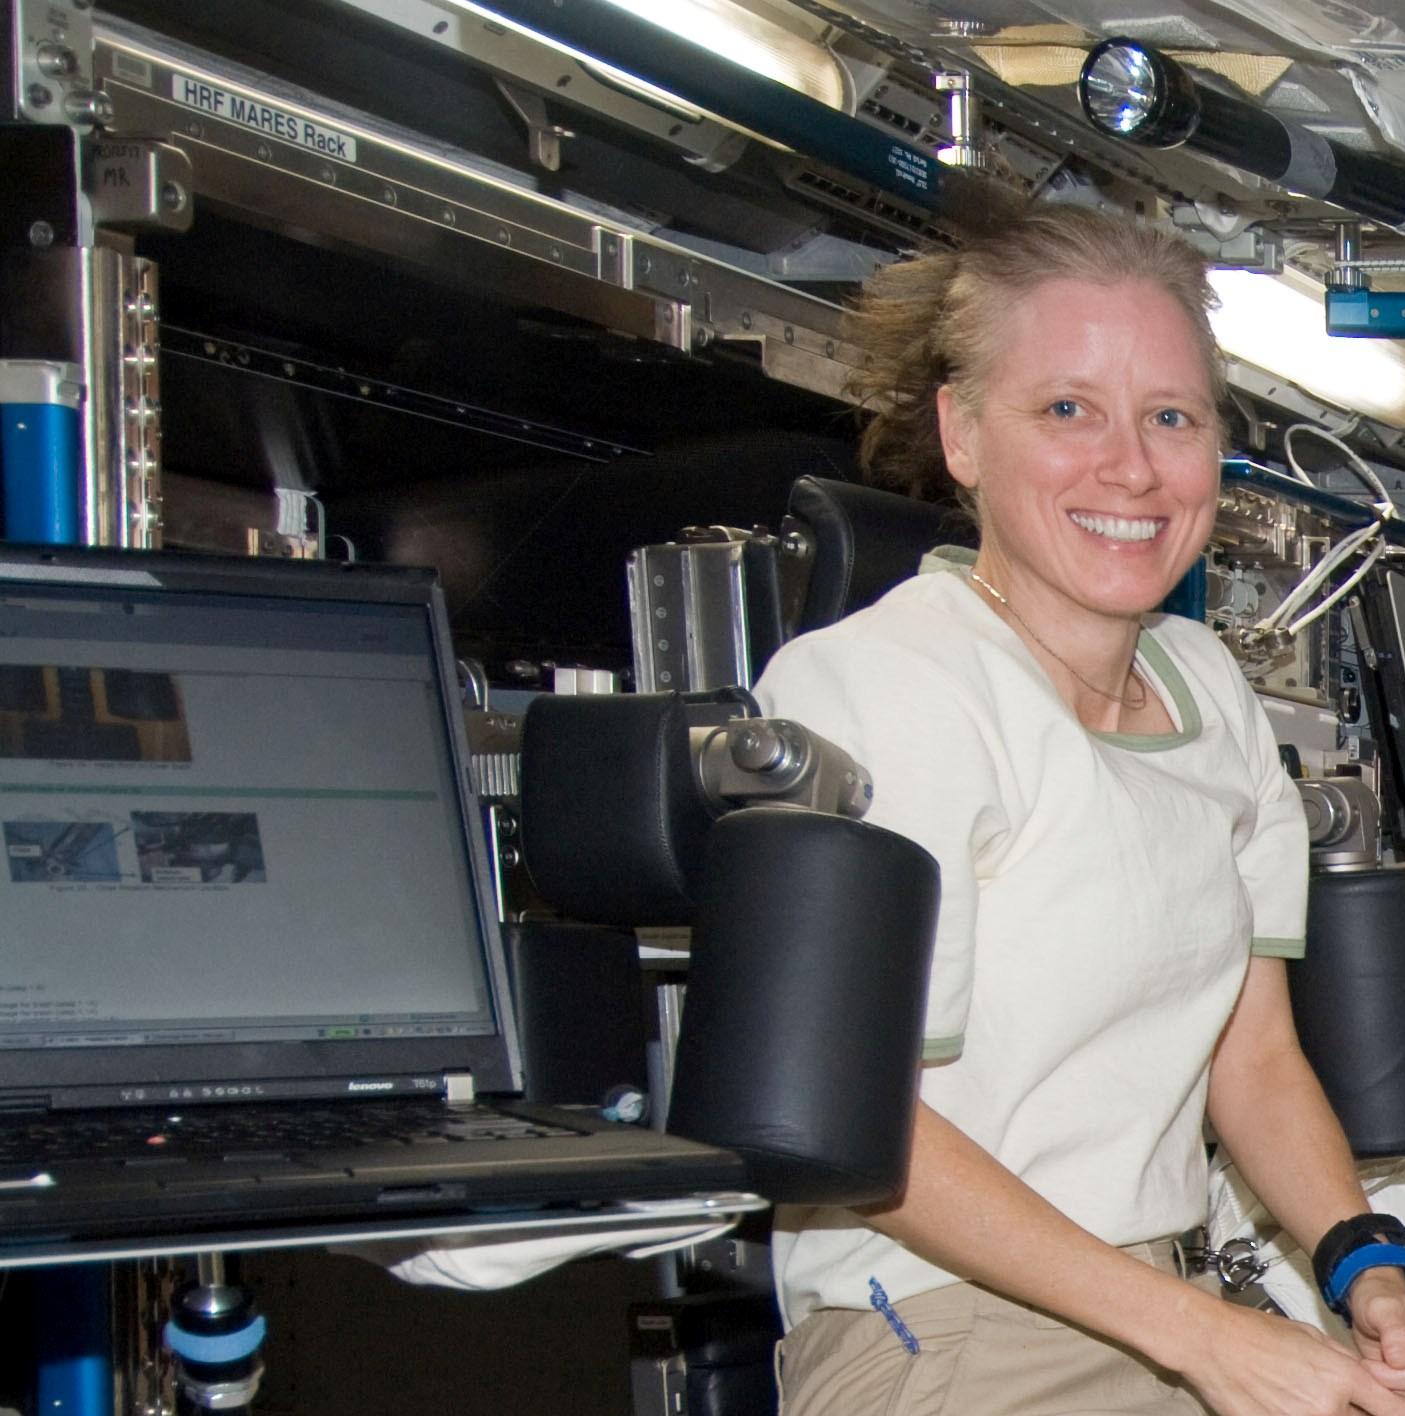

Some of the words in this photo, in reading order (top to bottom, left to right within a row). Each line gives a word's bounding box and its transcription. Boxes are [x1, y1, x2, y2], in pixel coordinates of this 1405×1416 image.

[185, 79, 226, 116] HRF
[229, 96, 298, 141] MARES
[303, 120, 347, 158] Rack
[348, 1080, 394, 1091] lenovo
